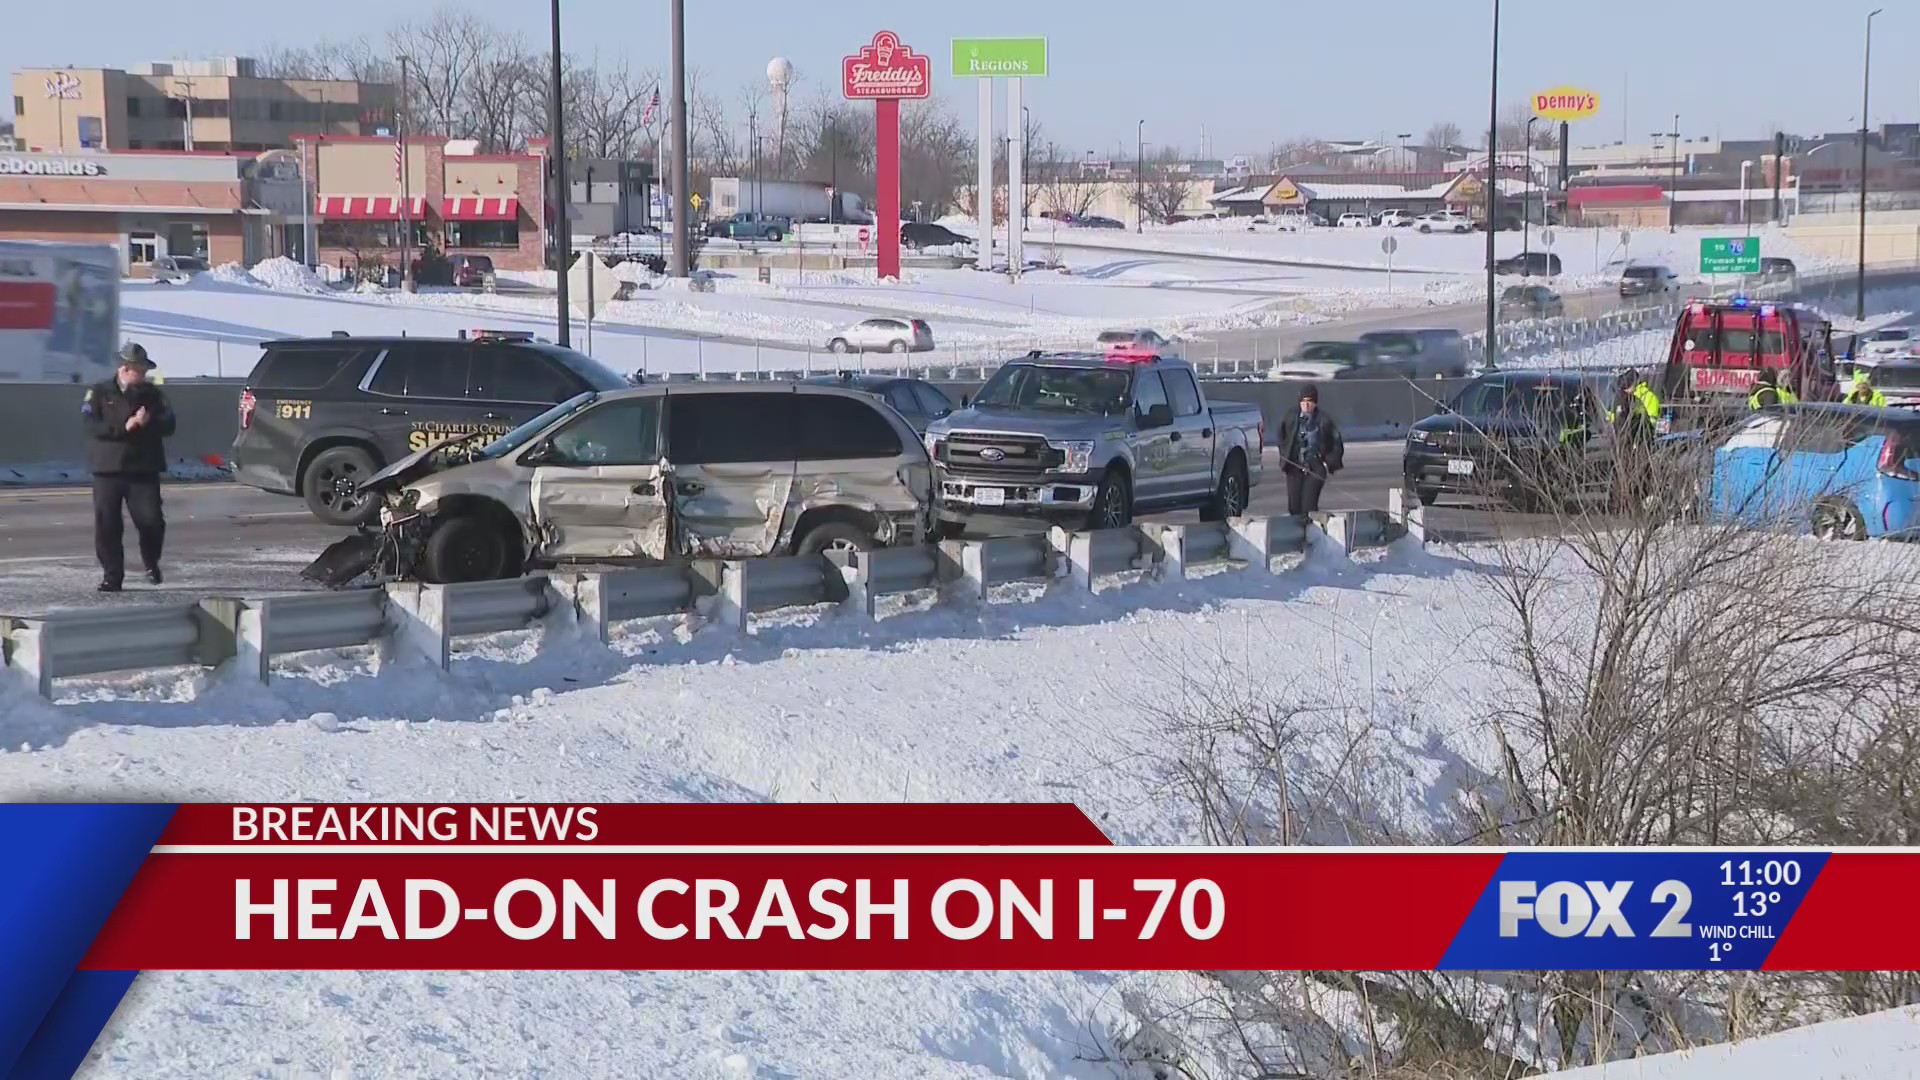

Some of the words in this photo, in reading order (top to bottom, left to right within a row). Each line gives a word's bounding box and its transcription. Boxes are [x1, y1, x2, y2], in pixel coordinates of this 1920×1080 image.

[969, 59, 1029, 71] REGIONS
[849, 63, 924, 87] Freddy's
[1537, 93, 1595, 111] Denny's
[0, 158, 99, 175] cDonald's
[281, 404, 311, 419] 911
[480, 423, 516, 434] COUN
